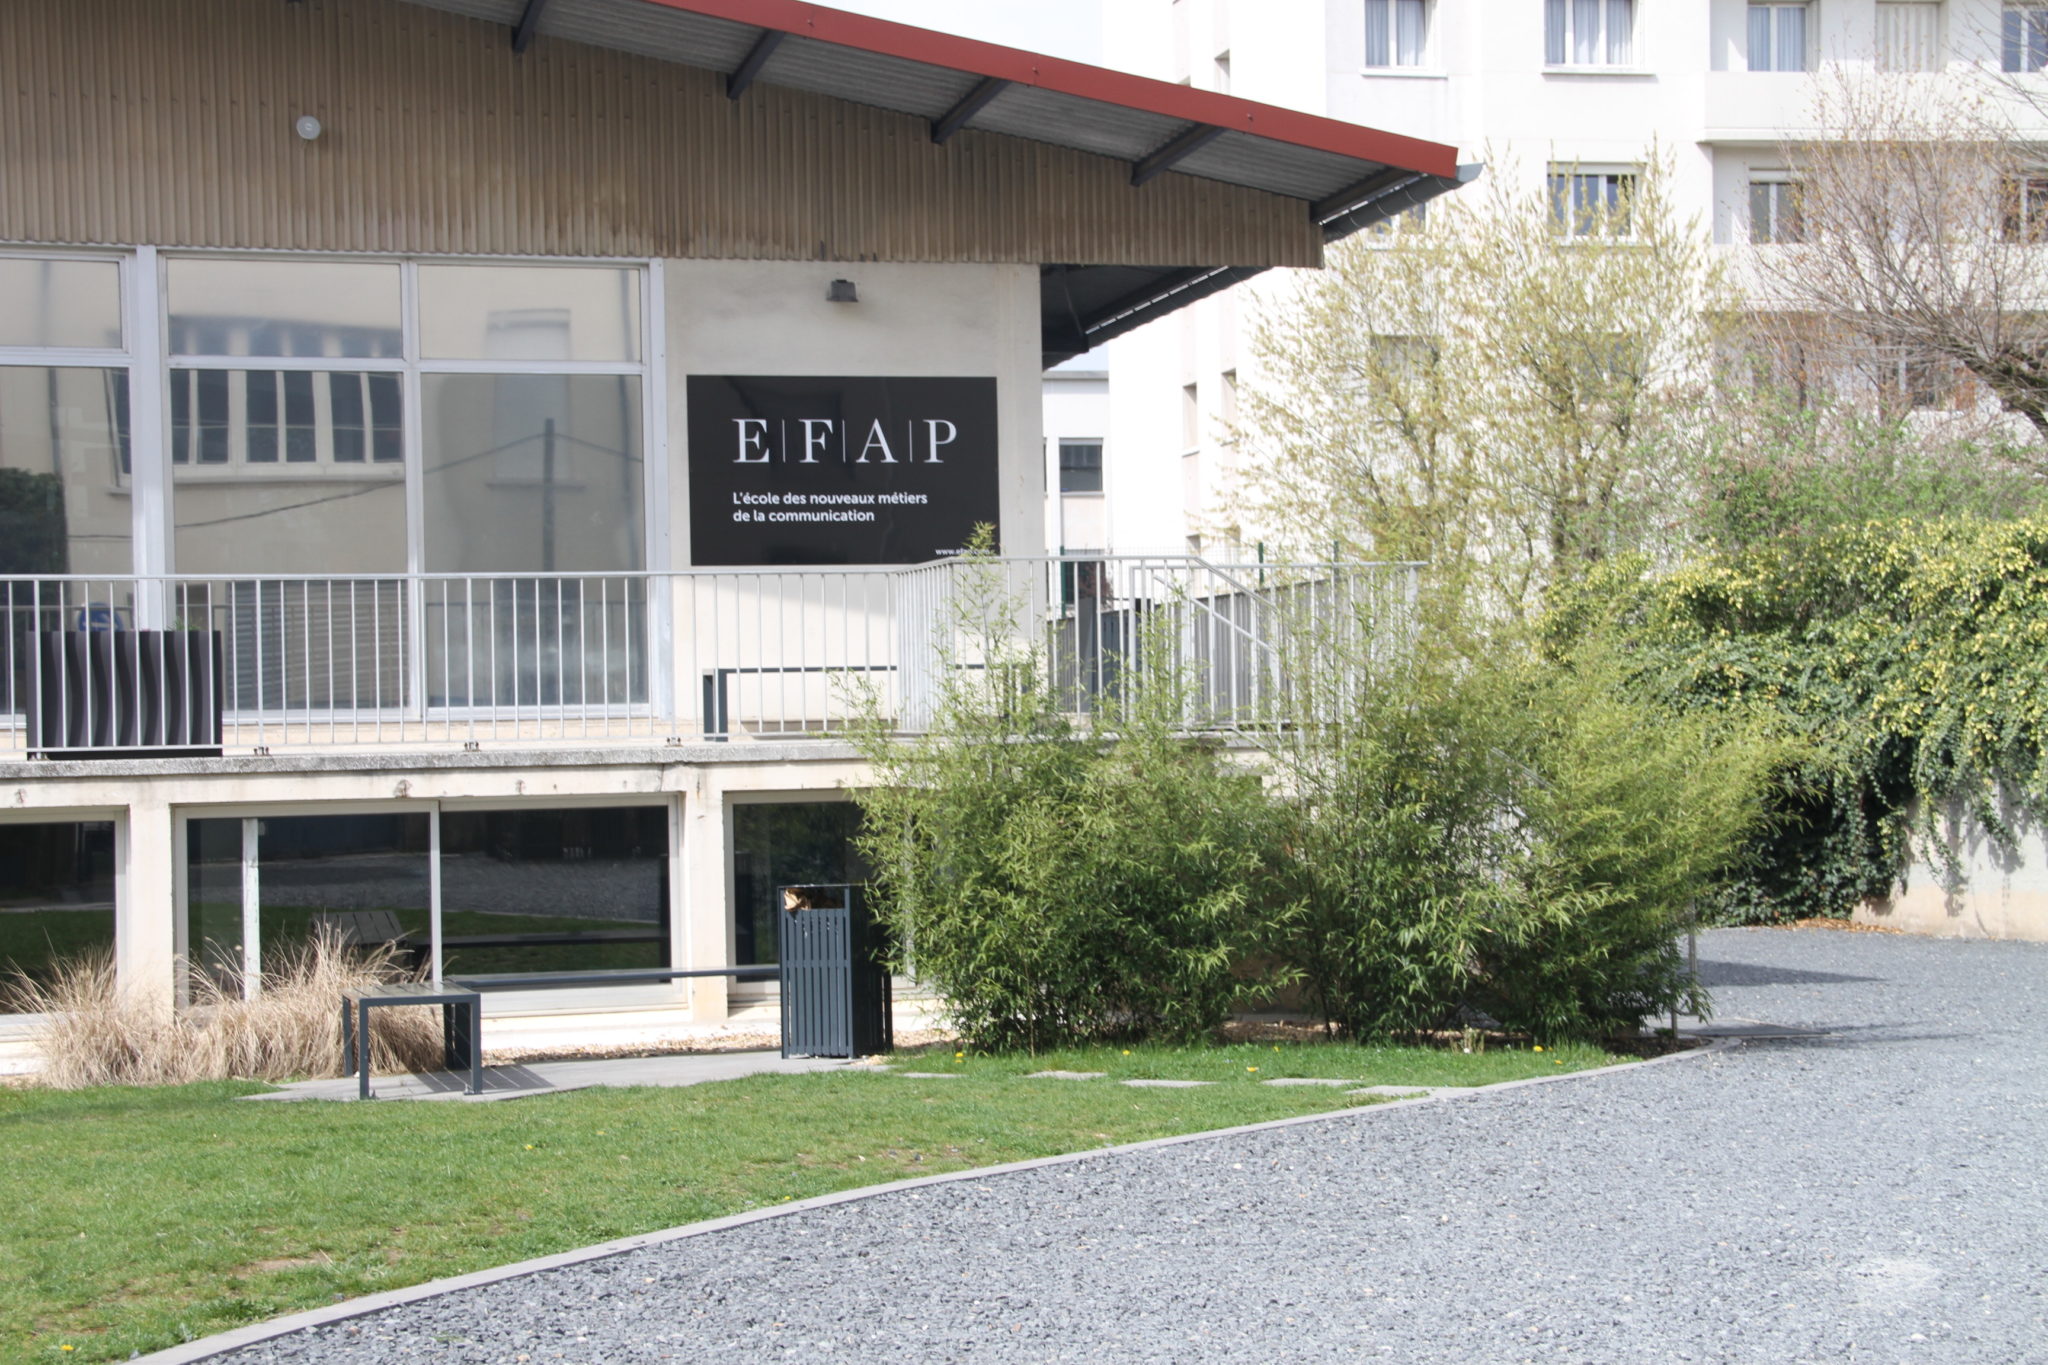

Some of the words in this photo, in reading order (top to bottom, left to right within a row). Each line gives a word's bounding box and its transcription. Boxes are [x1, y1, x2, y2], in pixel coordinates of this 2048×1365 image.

[732, 491, 780, 505] L'école
[782, 491, 806, 505] des
[809, 493, 875, 505] nouveaux
[877, 491, 928, 505] métiers
[732, 508, 751, 522] de
[753, 508, 766, 522] la
[768, 508, 875, 522] communication
